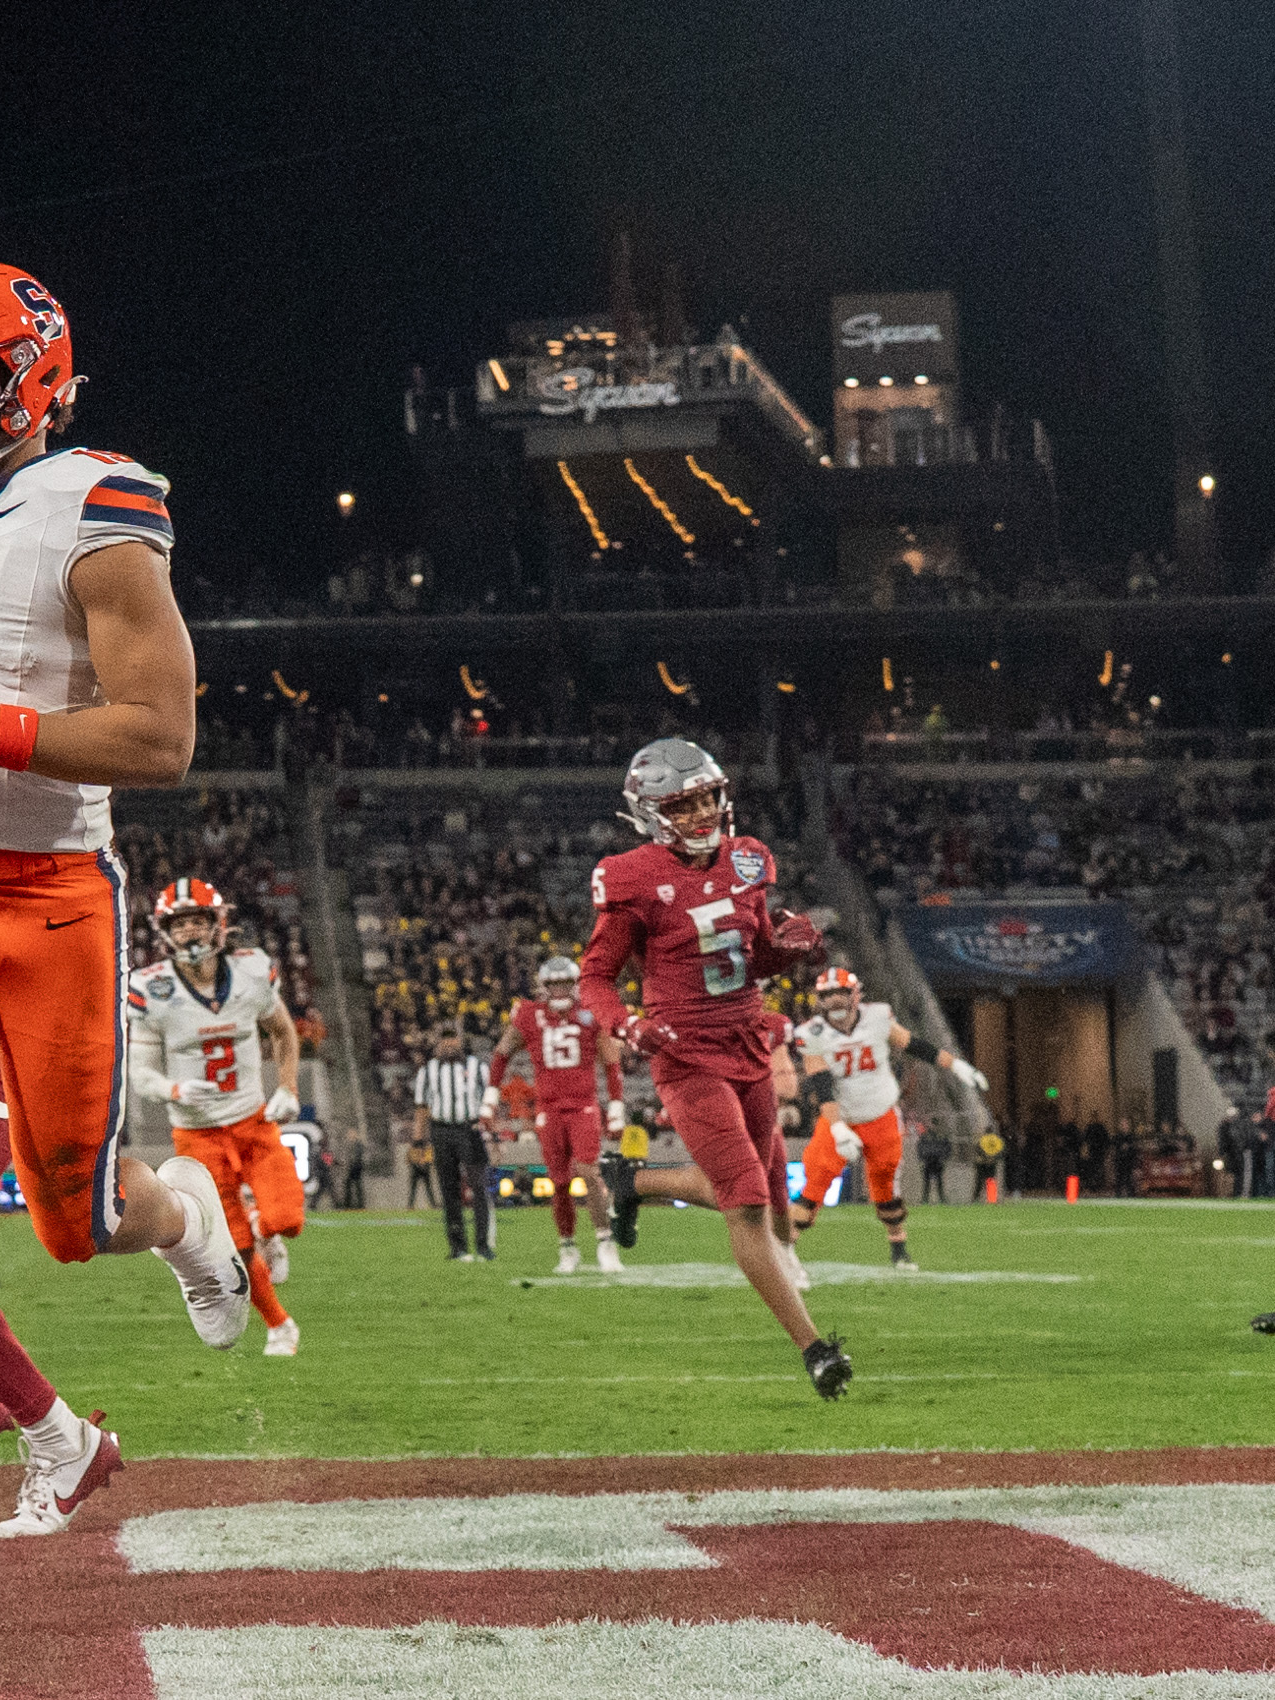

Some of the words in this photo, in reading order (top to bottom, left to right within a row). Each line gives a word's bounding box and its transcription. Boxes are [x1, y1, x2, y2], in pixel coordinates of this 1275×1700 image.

[592, 868, 606, 904] 5
[686, 897, 749, 996] 5
[202, 1037, 237, 1093] 2
[543, 1024, 581, 1069] 15
[835, 1046, 877, 1077] 74
